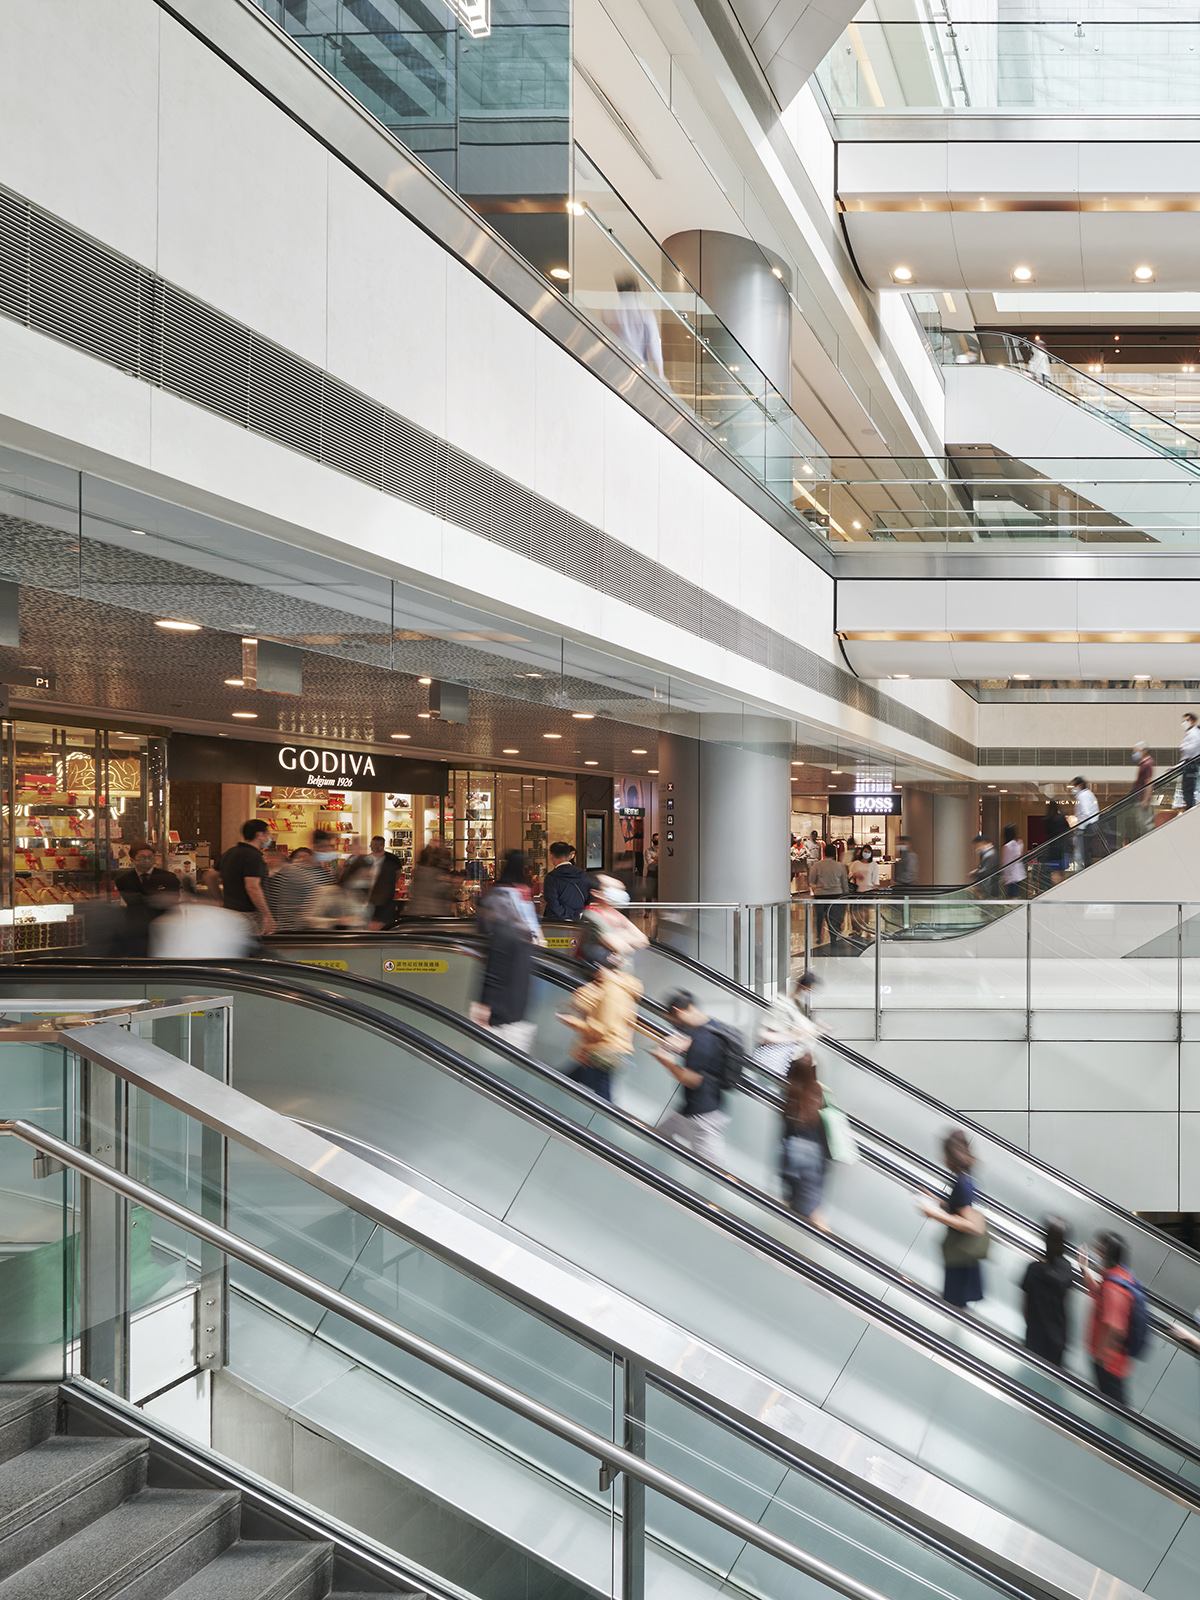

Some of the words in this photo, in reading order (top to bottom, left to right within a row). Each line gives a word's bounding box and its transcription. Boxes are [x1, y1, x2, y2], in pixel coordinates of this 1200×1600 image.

[35, 677, 49, 688] P1
[278, 747, 376, 777] GODIVA
[307, 774, 336, 787] Belgium
[336, 777, 353, 787] 1926
[854, 797, 894, 809] BOSS
